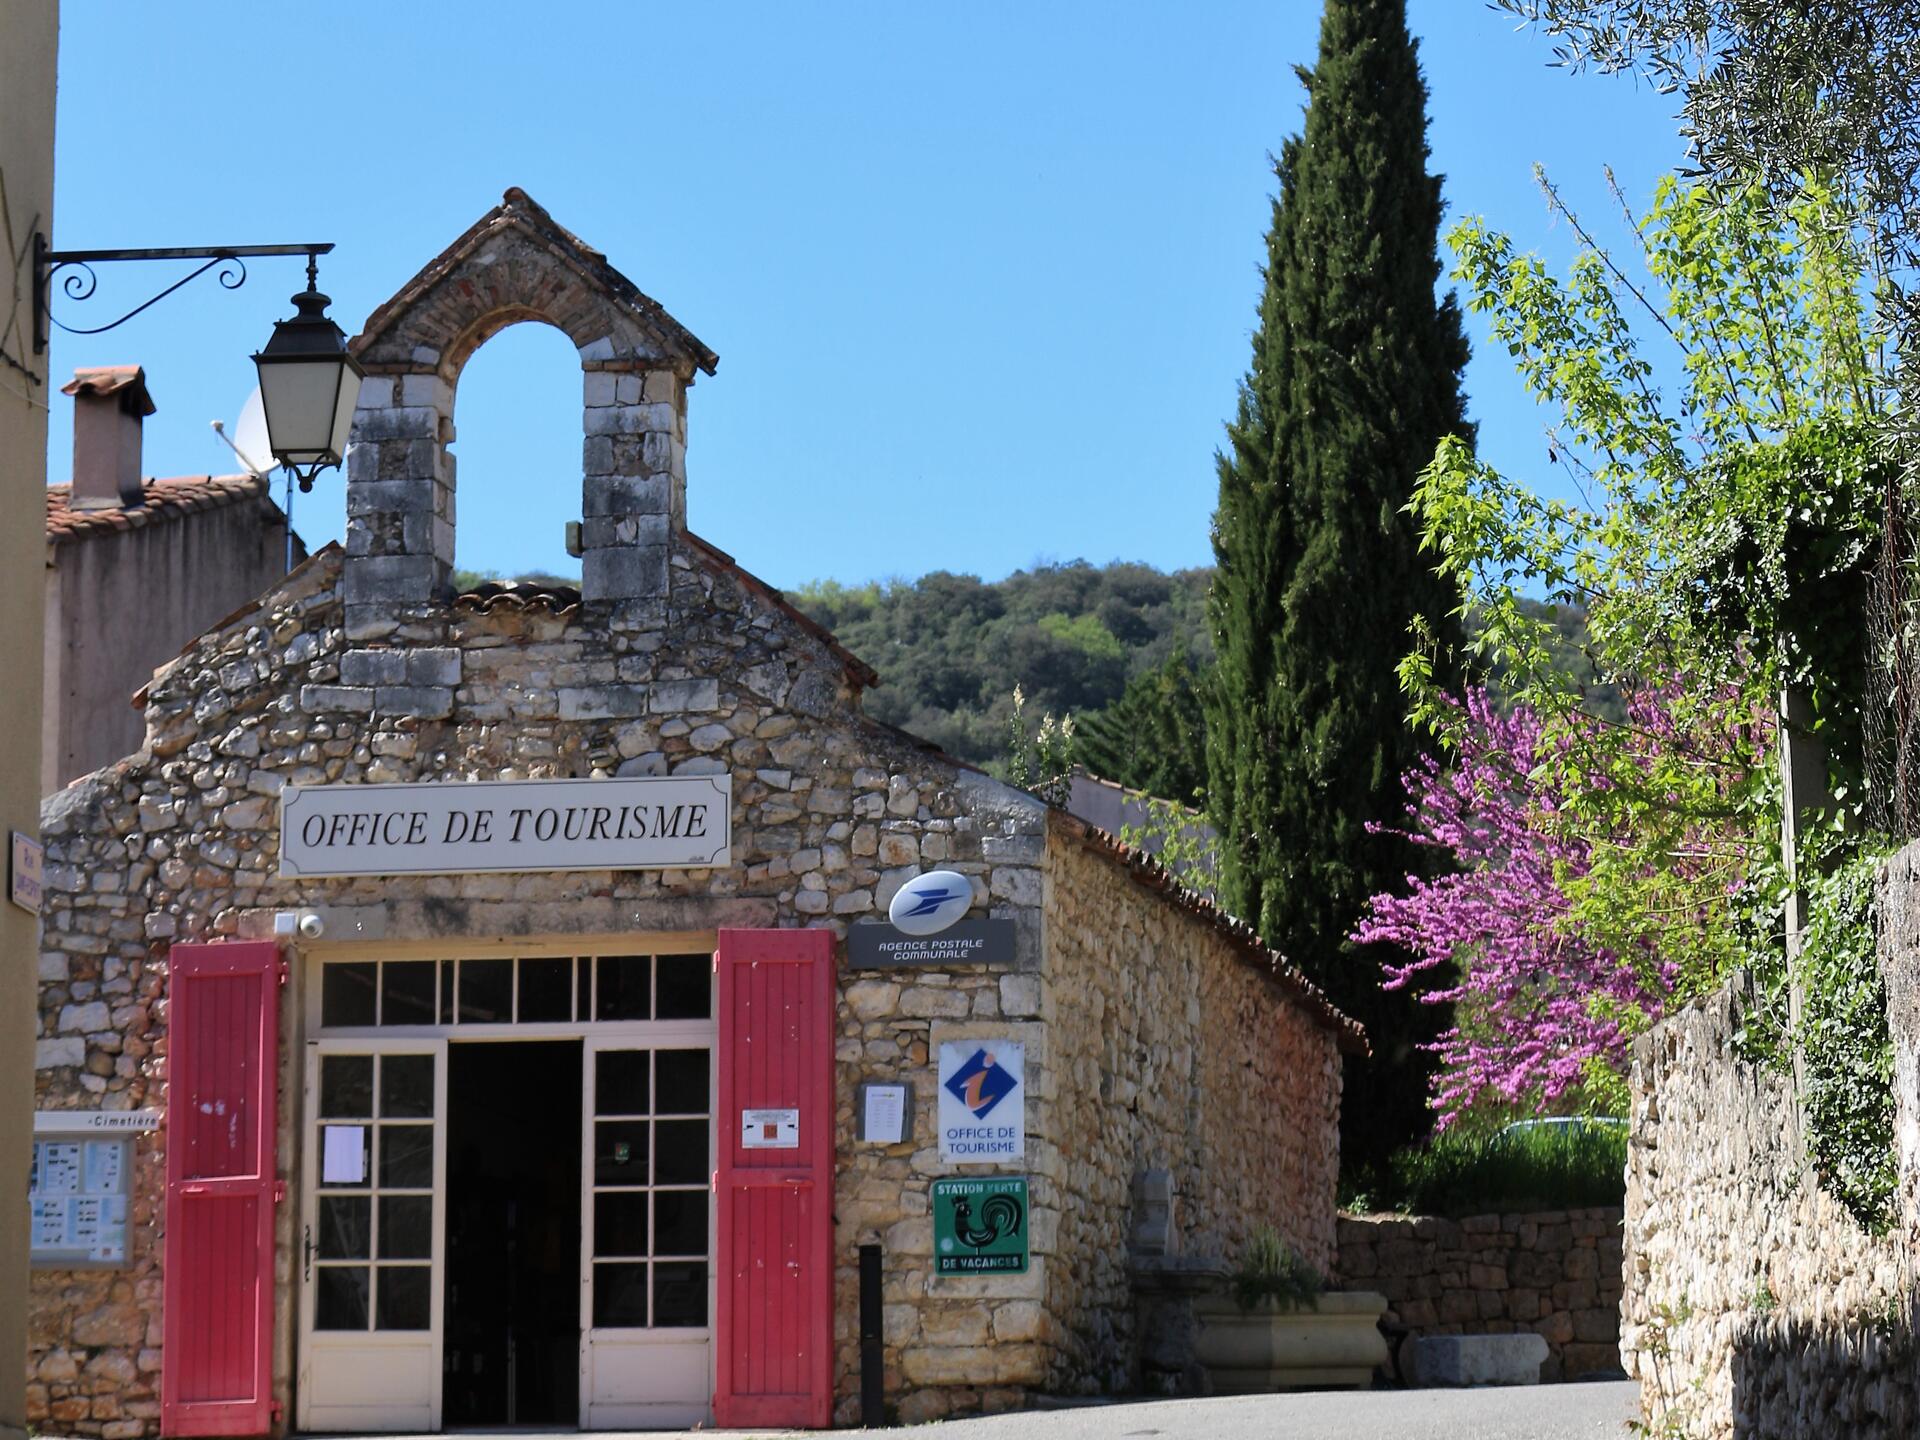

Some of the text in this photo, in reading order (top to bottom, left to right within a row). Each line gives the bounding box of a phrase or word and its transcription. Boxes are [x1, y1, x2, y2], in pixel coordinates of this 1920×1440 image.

[302, 804, 708, 847] OFFICE DE TOURISME
[878, 939, 984, 951] AGENCE POSTALE
[893, 950, 969, 960] COMMUNALE
[946, 1127, 1016, 1140] OFFICE DE
[948, 1141, 1015, 1154] TOURISME
[938, 1182, 1022, 1195] STATION VERTE
[942, 1256, 1019, 1269] DE VACANCES
